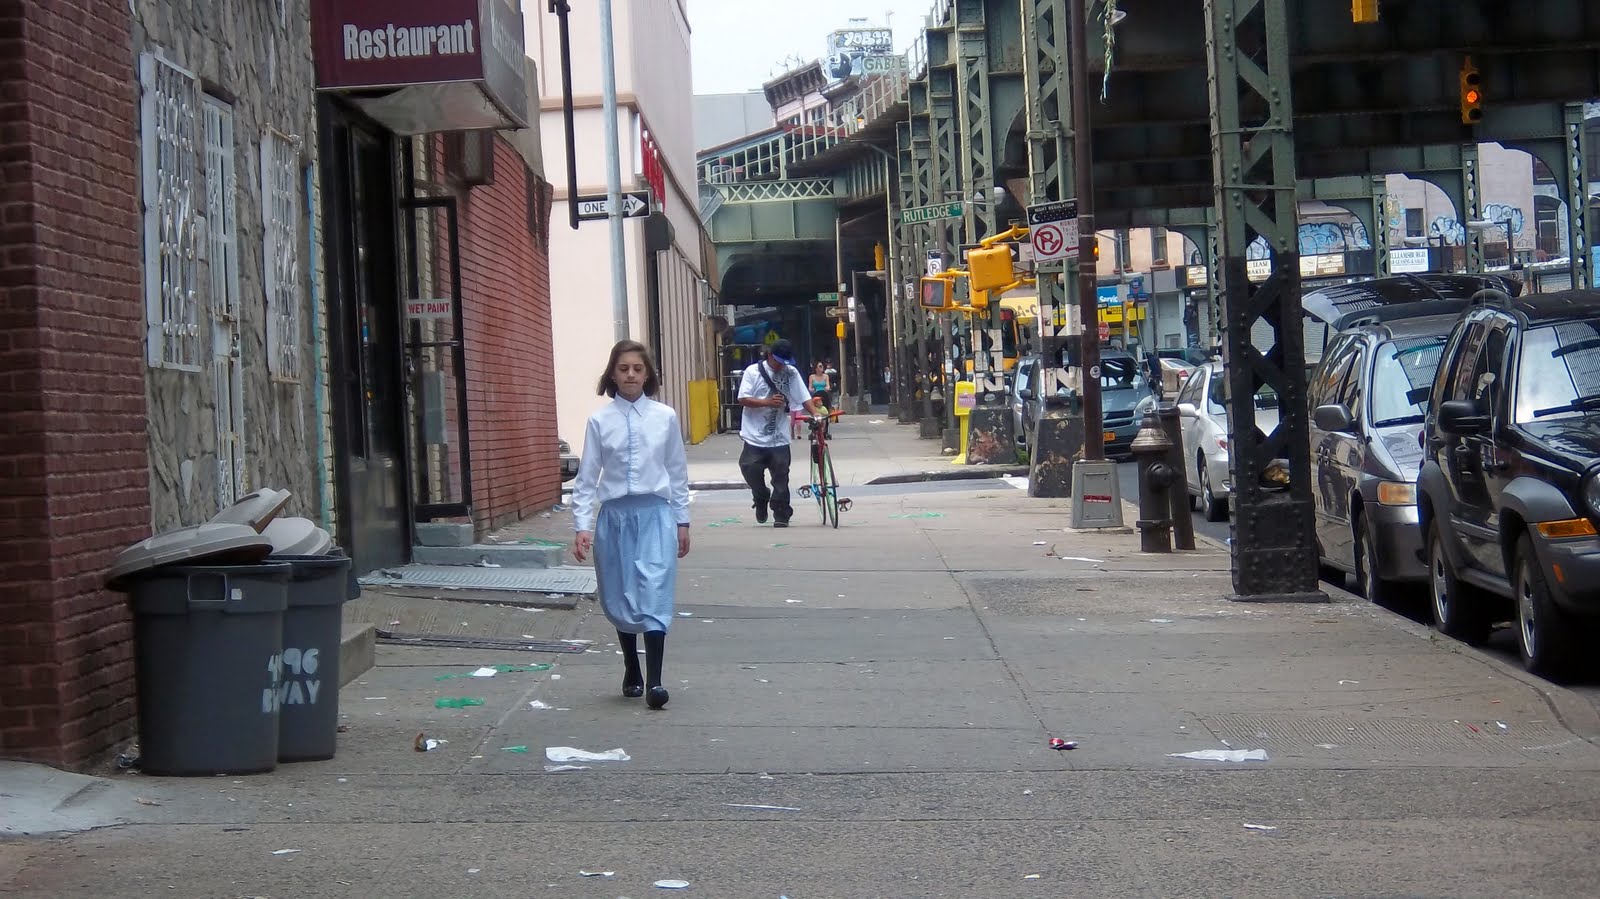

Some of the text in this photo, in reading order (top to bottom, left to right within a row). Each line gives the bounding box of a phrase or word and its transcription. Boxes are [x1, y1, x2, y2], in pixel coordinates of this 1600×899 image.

[343, 19, 475, 60] Restaurant
[584, 202, 606, 213] ONE
[903, 204, 952, 222] RUTLEDGE
[408, 303, 449, 313] WET PAINT
